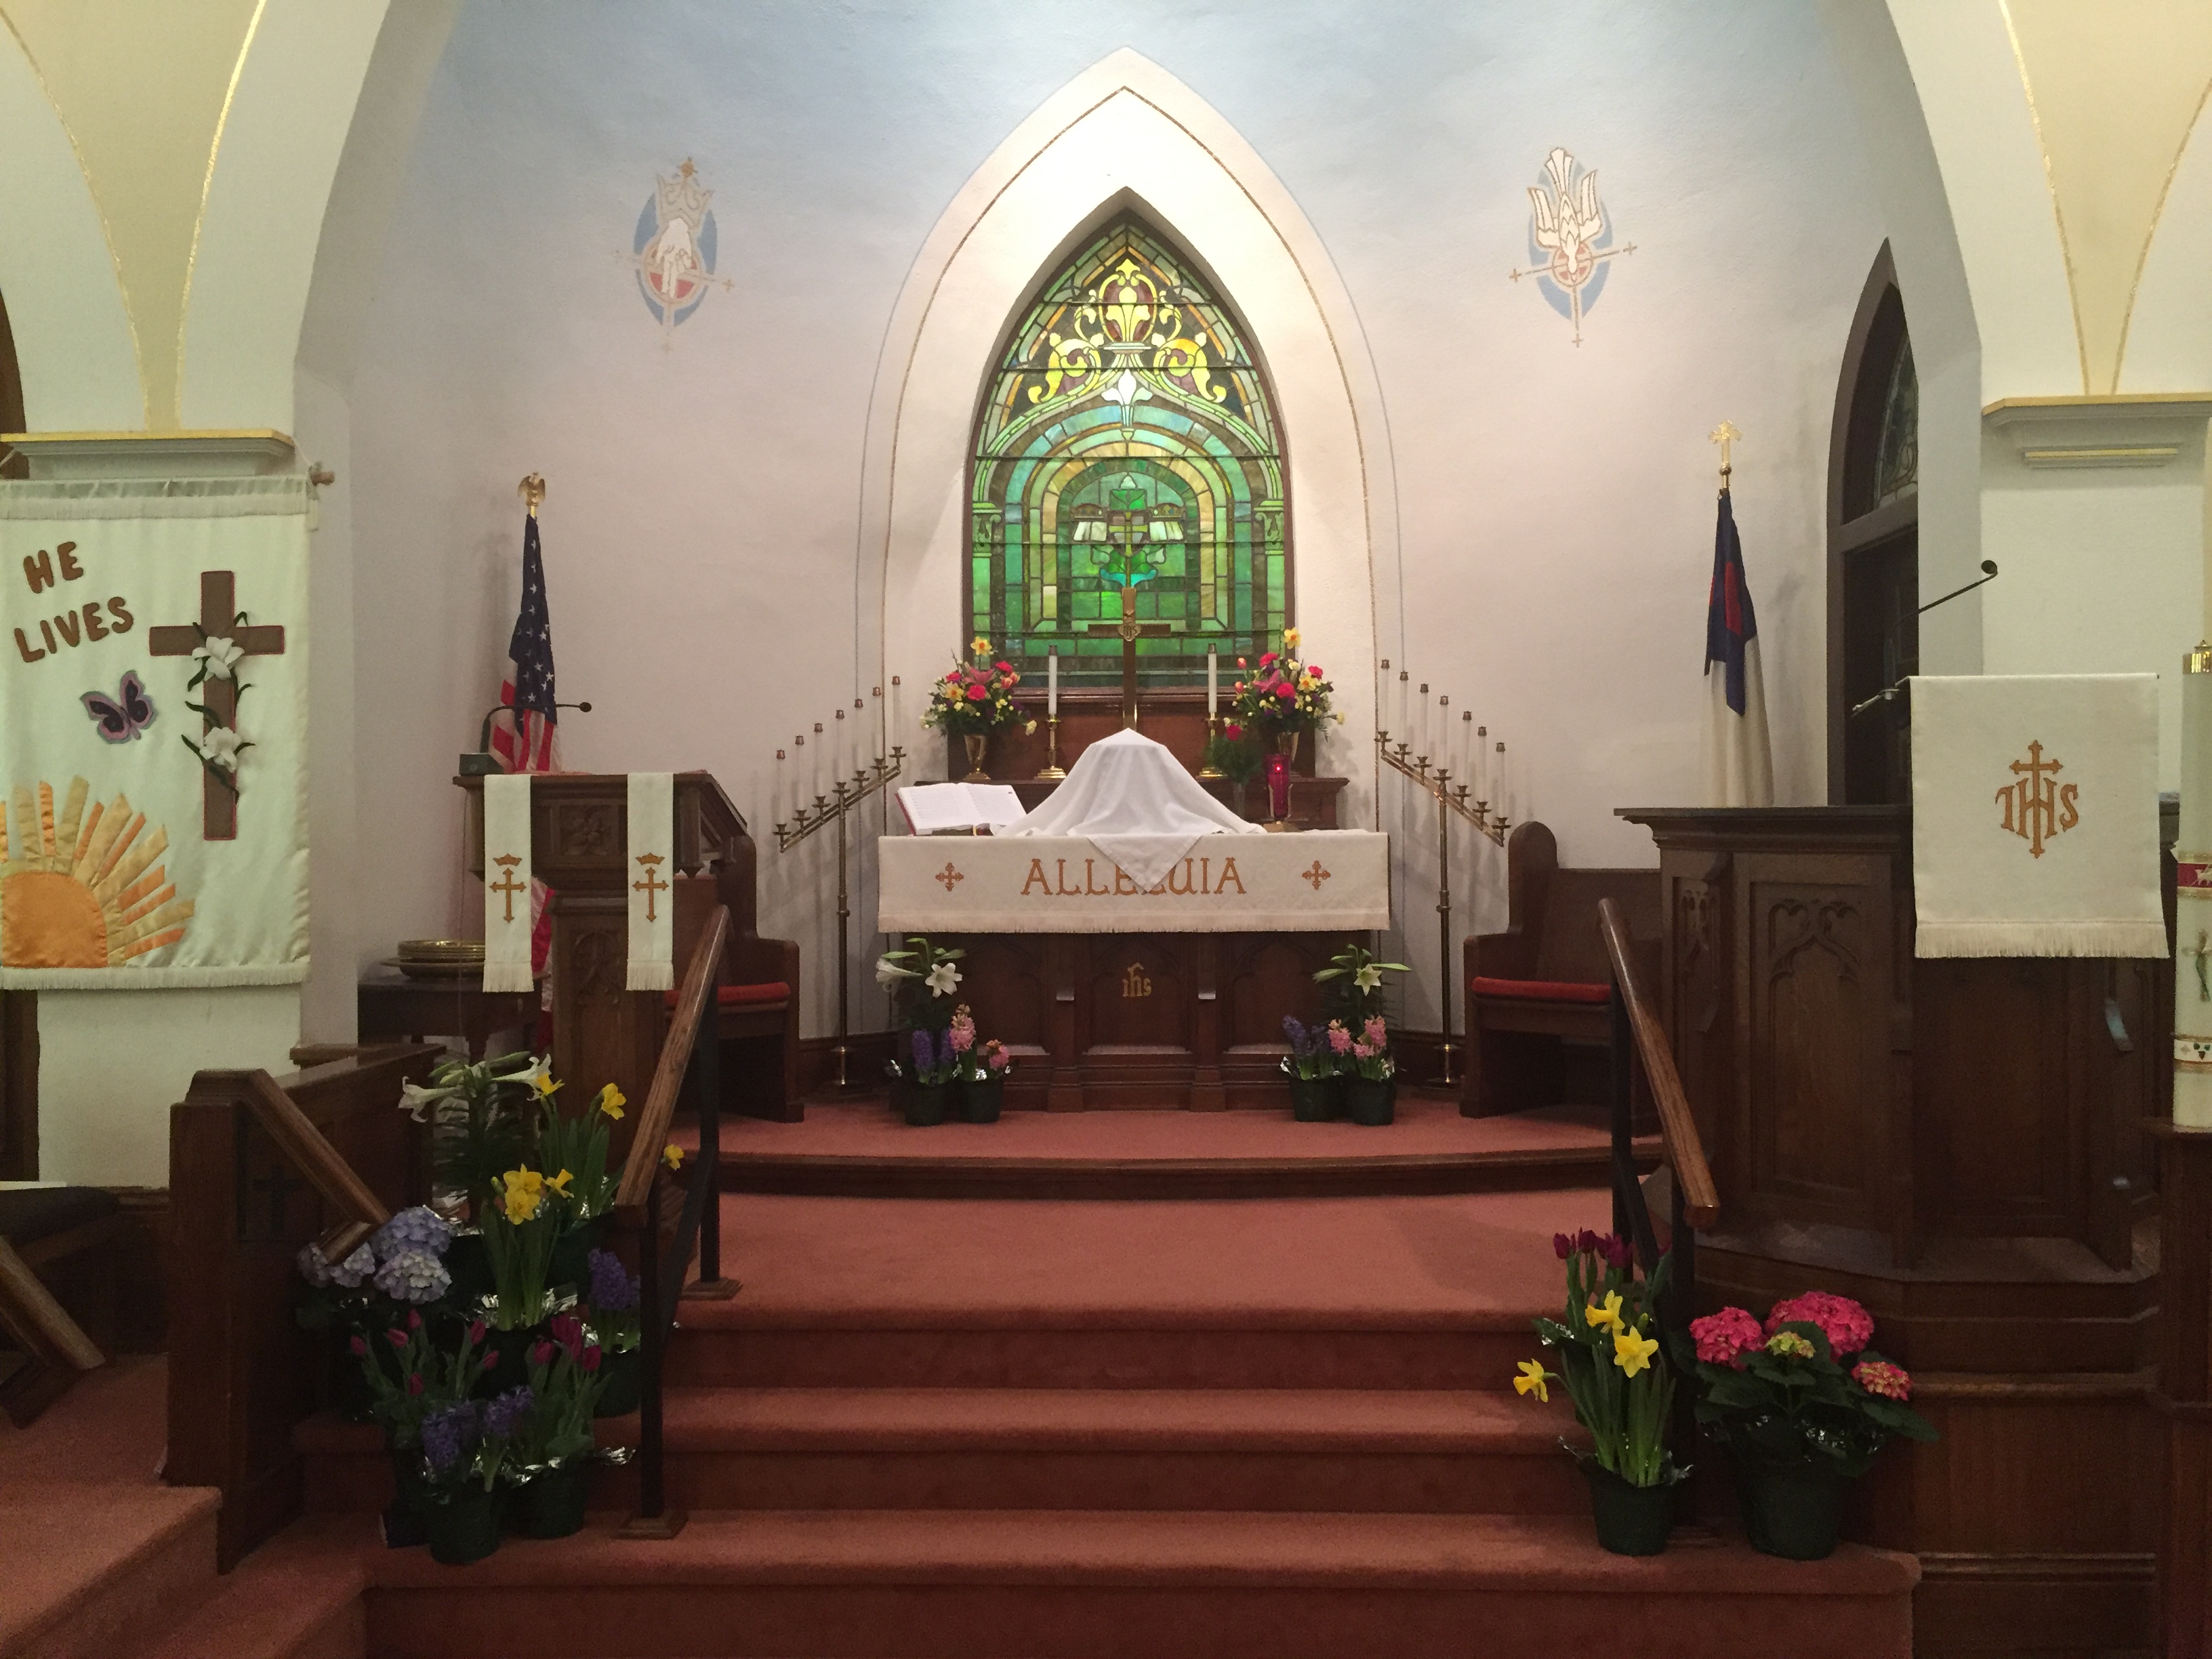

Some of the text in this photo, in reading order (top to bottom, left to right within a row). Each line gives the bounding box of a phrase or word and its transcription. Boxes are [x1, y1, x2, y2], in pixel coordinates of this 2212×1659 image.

[23, 541, 84, 594] HE
[14, 596, 134, 663] LIVES
[1995, 777, 2079, 840] IHS
